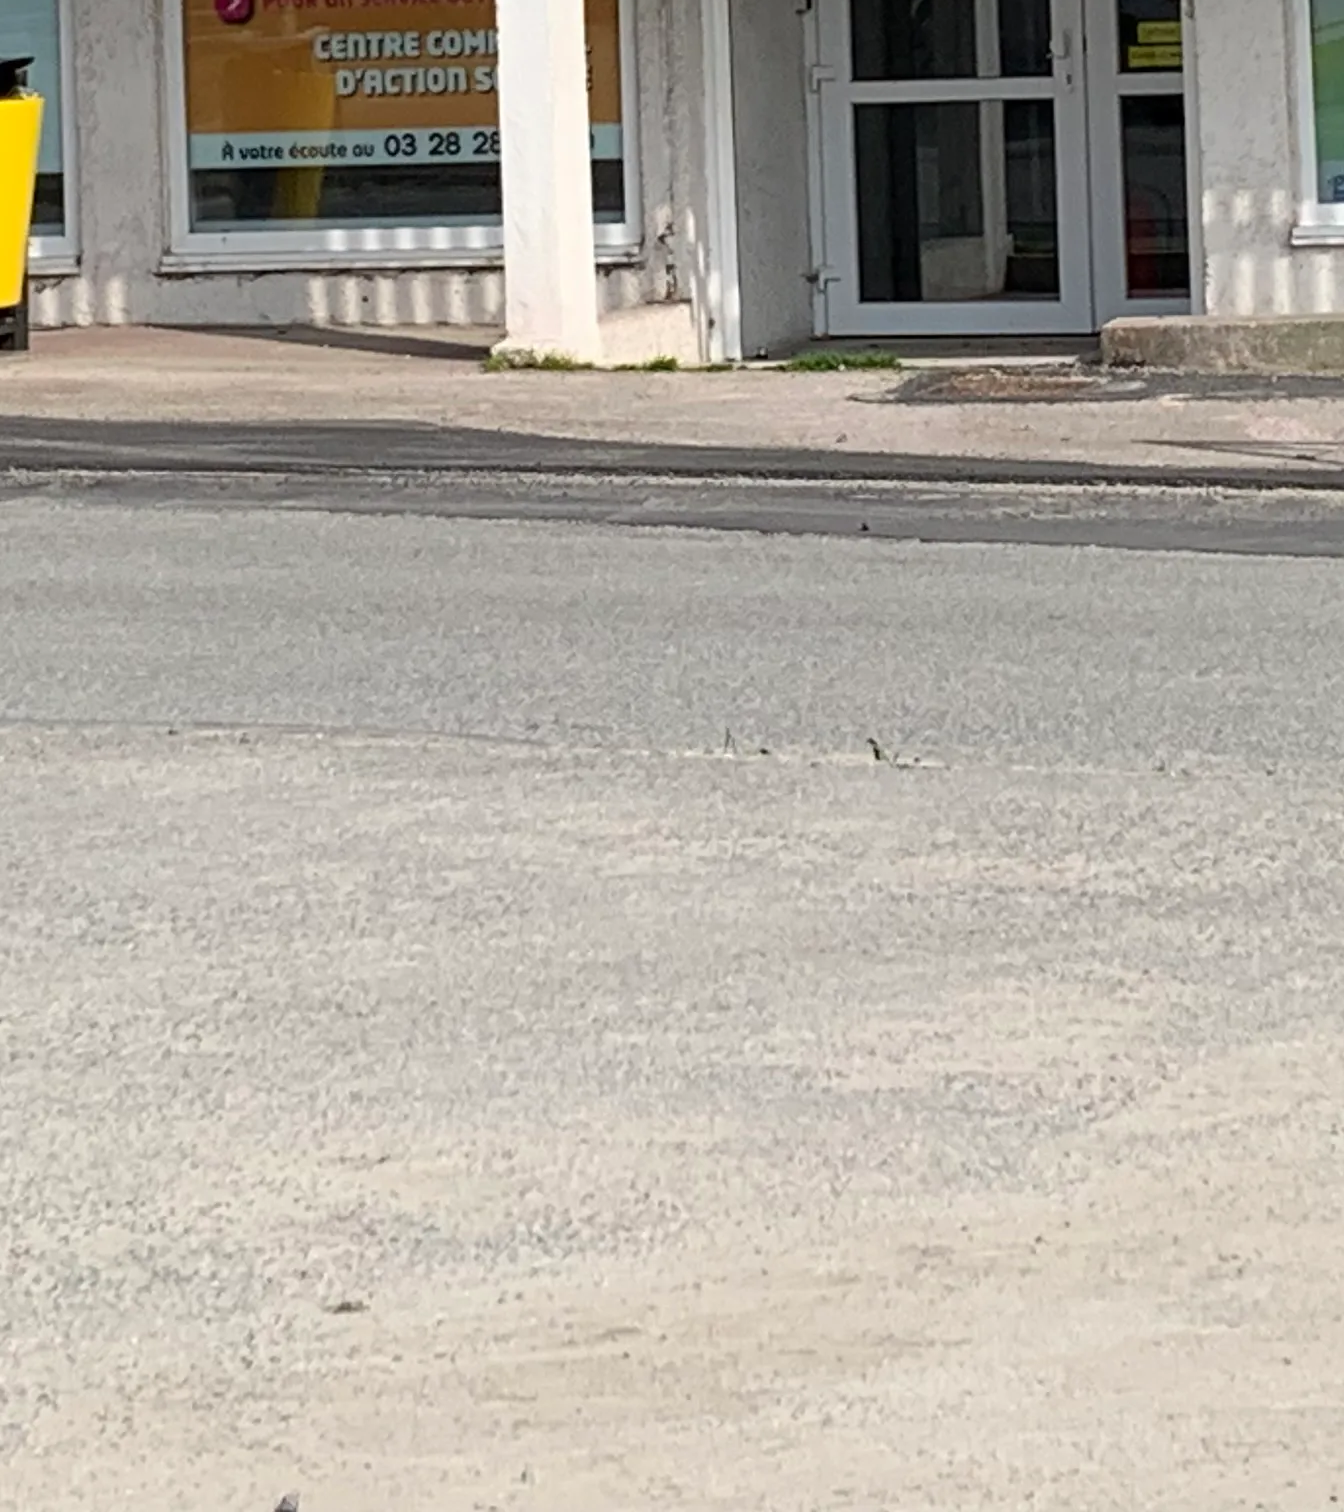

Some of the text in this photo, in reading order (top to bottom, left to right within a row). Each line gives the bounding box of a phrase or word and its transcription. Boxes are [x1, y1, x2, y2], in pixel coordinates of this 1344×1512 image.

[314, 28, 498, 62] CENTRE COM
[335, 67, 468, 96] D'ACTION
[222, 141, 234, 161] À
[239, 145, 284, 160] votre
[288, 142, 347, 159] écoute
[383, 135, 418, 157] 03
[428, 133, 461, 156] 28
[472, 131, 501, 154] 28
